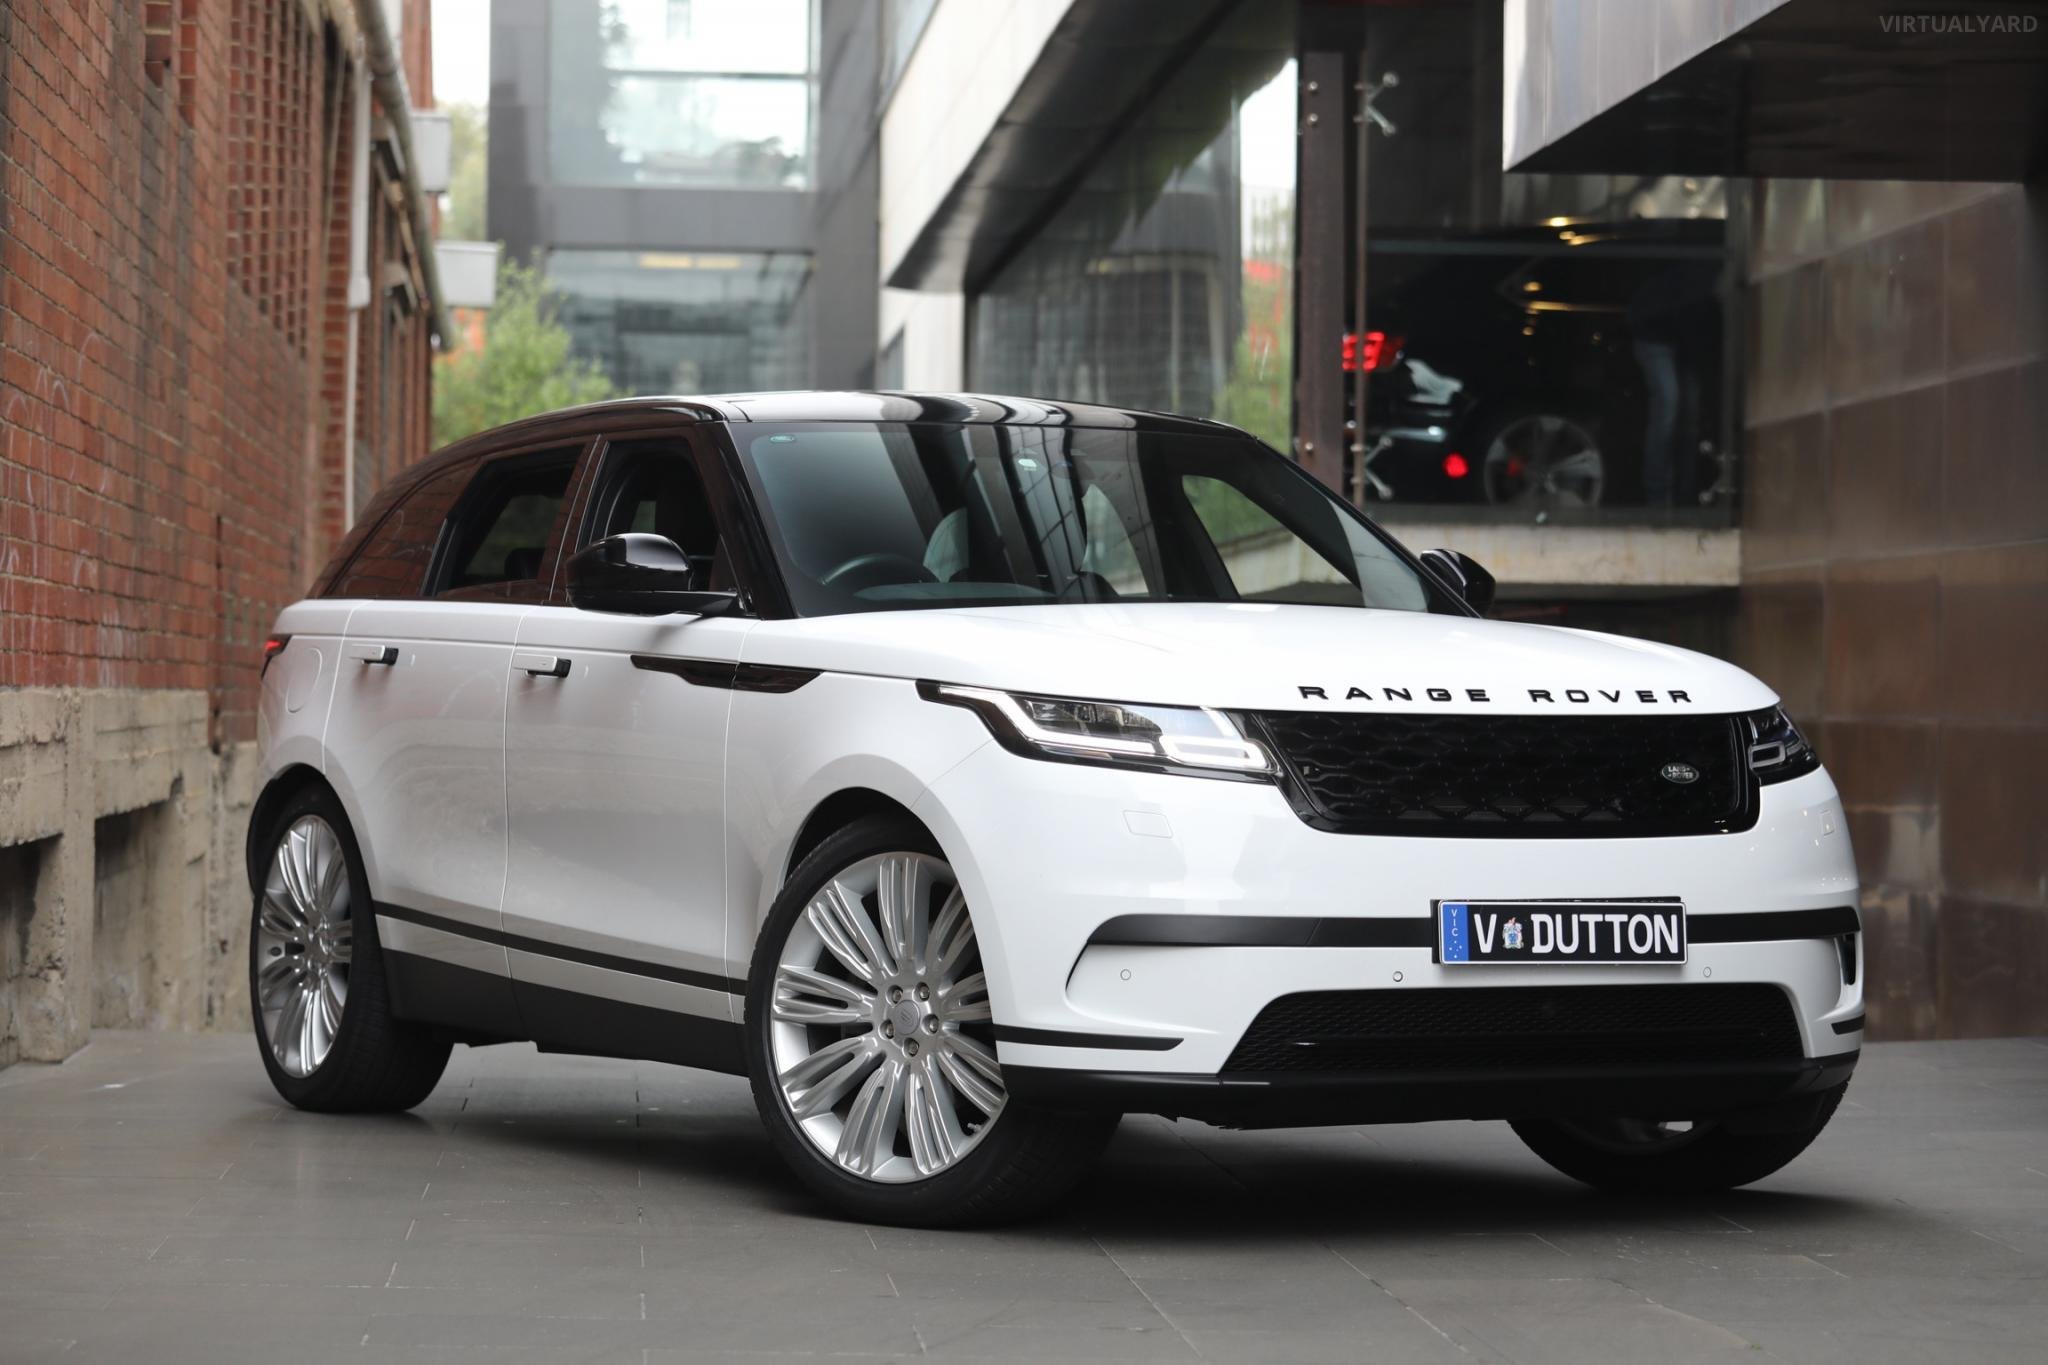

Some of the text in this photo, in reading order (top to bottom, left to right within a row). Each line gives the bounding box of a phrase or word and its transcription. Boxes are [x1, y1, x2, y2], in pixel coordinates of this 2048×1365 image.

[1298, 686, 1692, 703] RANGE ROVER
[1473, 913, 1679, 954] V DUTTON
